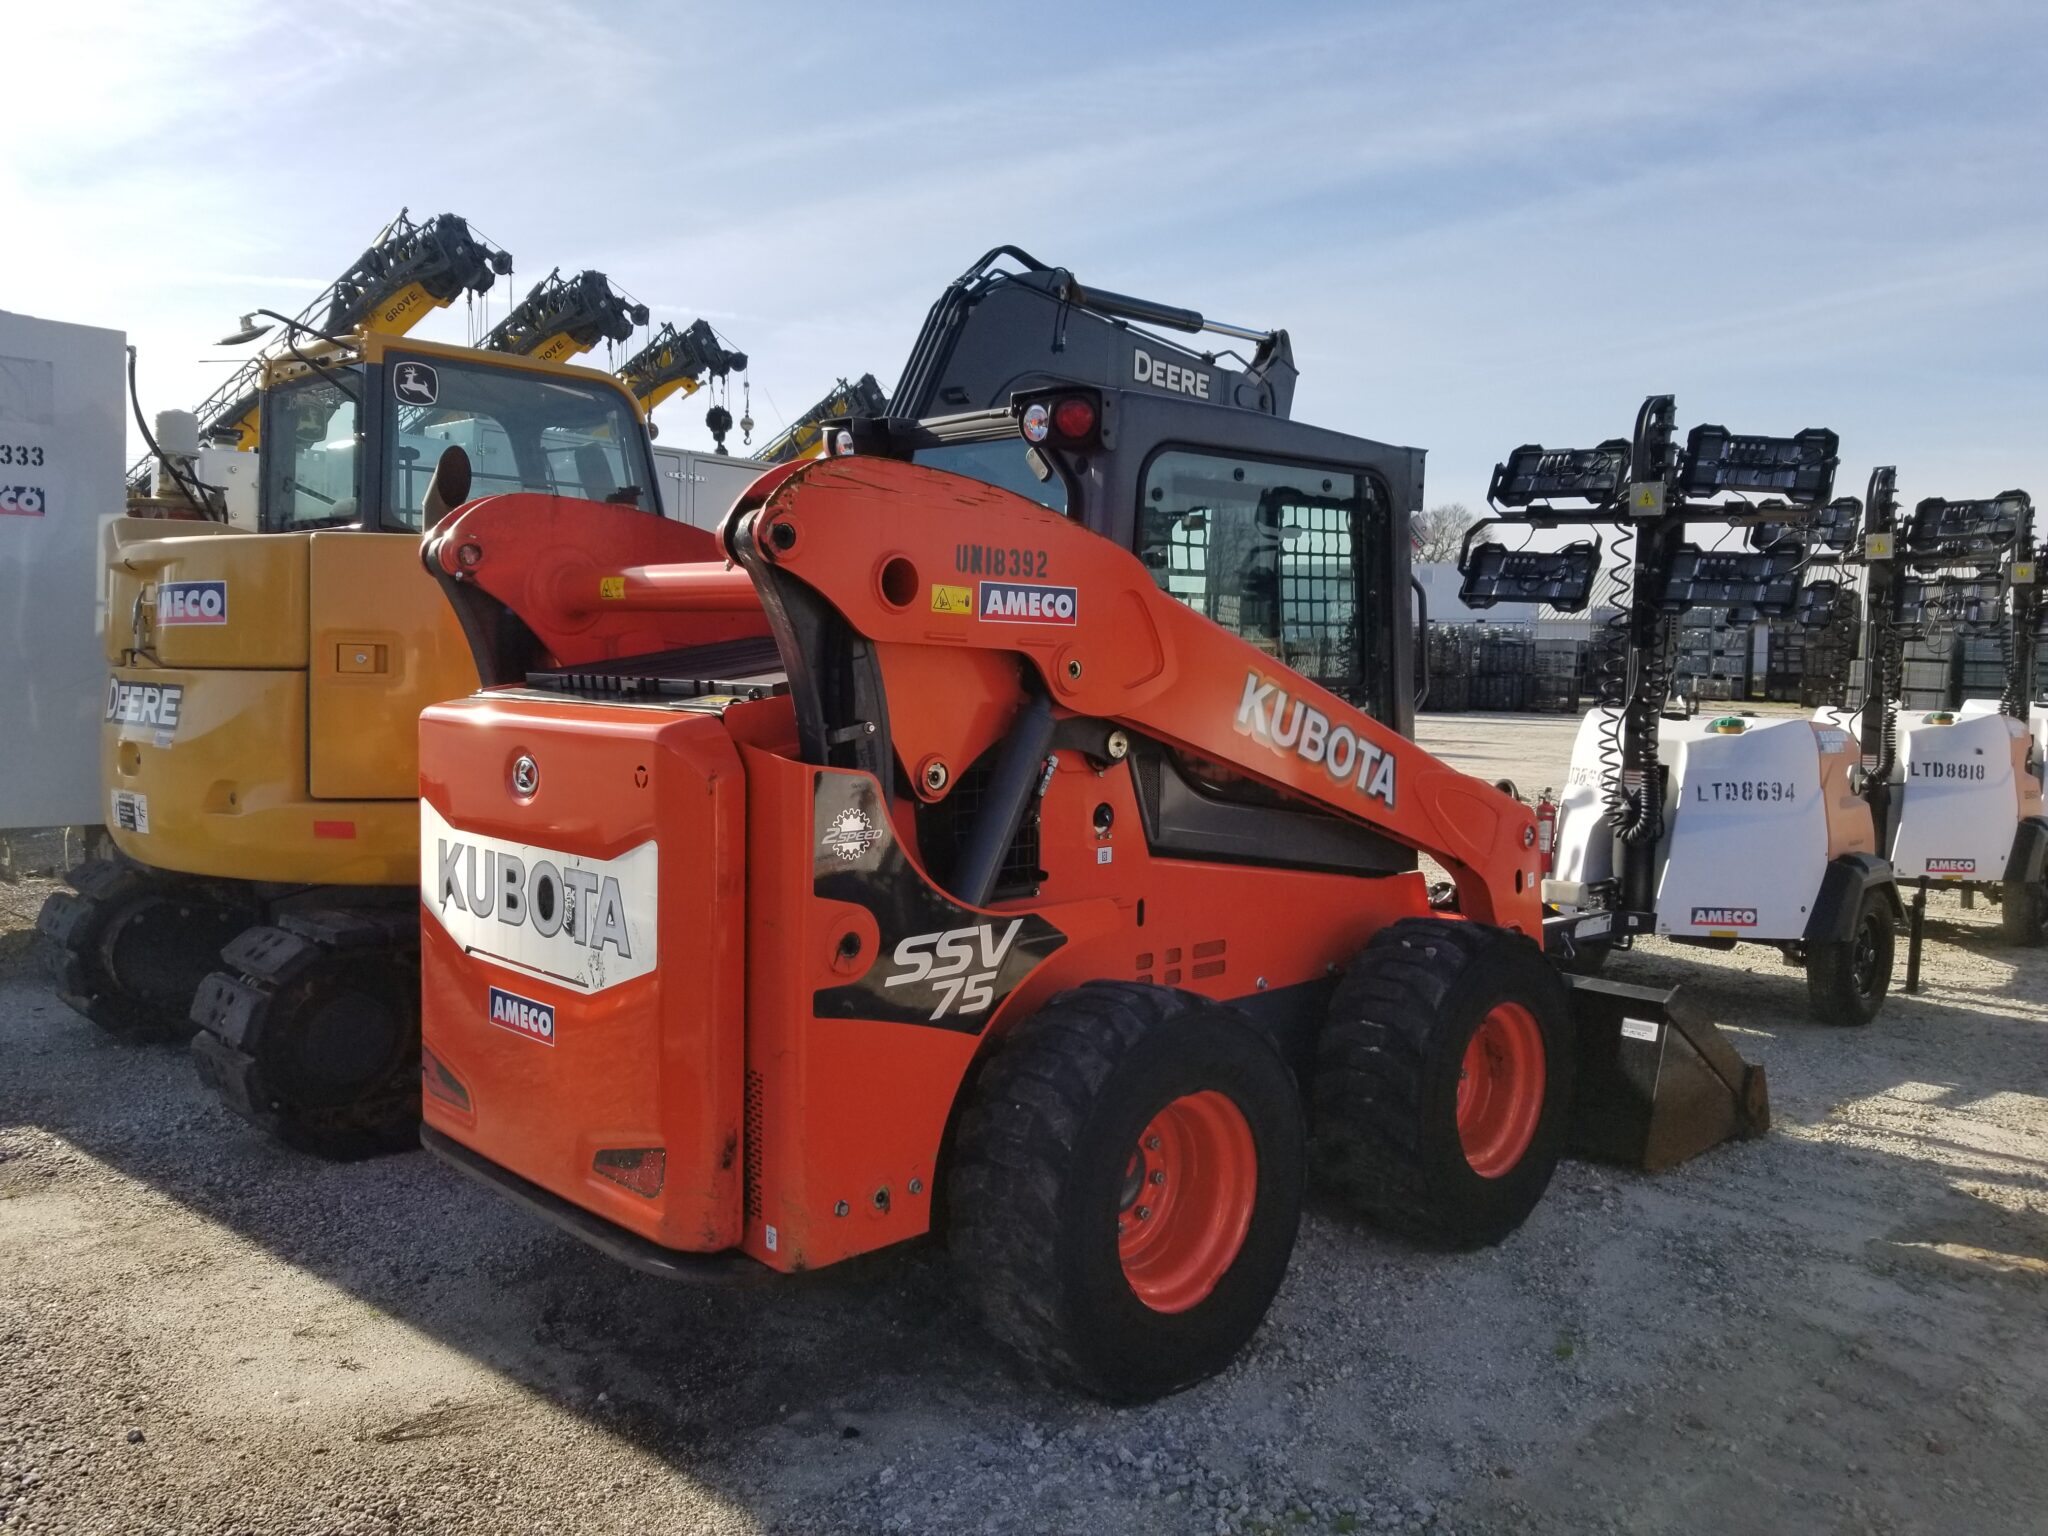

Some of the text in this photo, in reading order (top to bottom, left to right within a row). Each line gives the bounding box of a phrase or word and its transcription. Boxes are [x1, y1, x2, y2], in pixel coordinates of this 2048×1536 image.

[385, 291, 419, 322] GROVE
[1134, 349, 1210, 399] DEERE
[0, 444, 44, 467] 333
[157, 589, 222, 618] MECO
[986, 590, 1073, 618] AMECO
[105, 678, 182, 726] DEERE
[1237, 672, 1396, 806] KUBOTA
[1910, 762, 1985, 781] LTD8818
[1697, 781, 1796, 803] LTD8694
[1928, 859, 1975, 872] AMECO
[438, 838, 632, 960] KUBOTA
[1695, 909, 1756, 924] AMECO
[885, 918, 1024, 988] SSV
[928, 970, 998, 1021] 75
[493, 996, 552, 1037] AMECO
